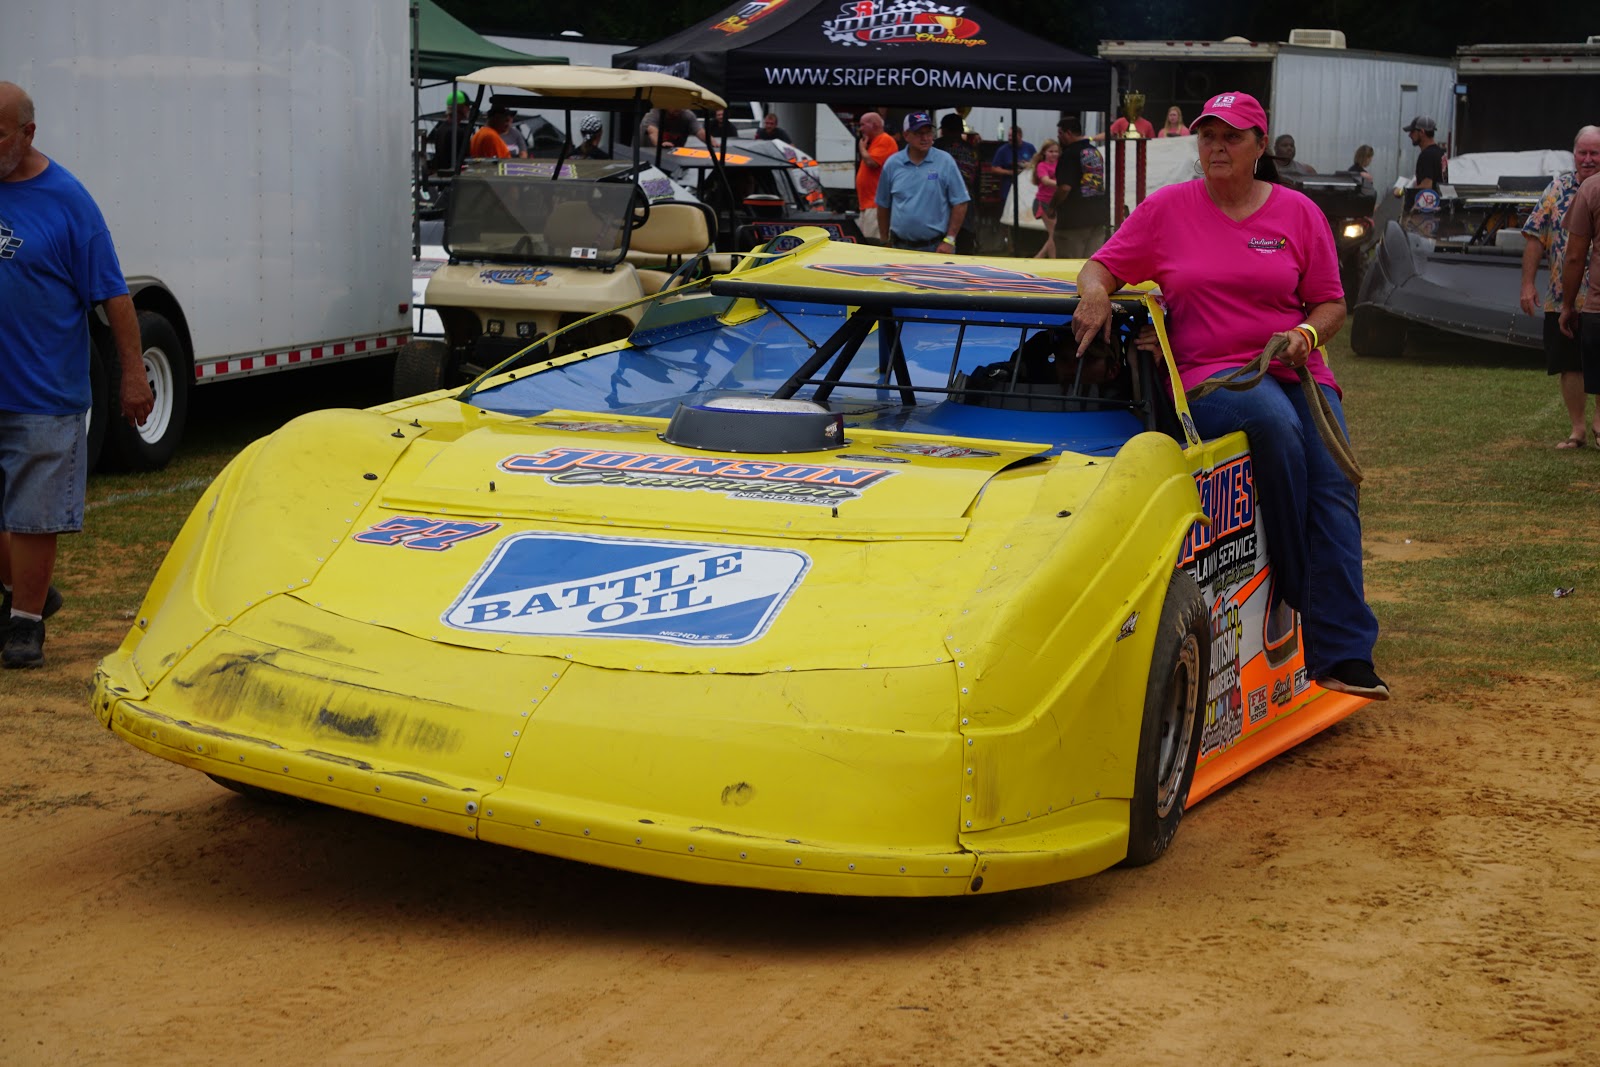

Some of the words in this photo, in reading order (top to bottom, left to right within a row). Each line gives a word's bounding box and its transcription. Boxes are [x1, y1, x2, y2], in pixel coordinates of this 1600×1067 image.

[834, 10, 921, 33] DIRT
[869, 24, 945, 41] CUP
[915, 32, 987, 47] Challenge
[764, 66, 1072, 93] WWW.SRIPERFORMANCE.COM
[504, 449, 889, 487] JOHNSON
[565, 468, 861, 498] Construction
[353, 515, 499, 550] 77
[1197, 550, 1218, 581] LAWN
[1219, 532, 1255, 567] SERVICE
[464, 551, 743, 624] BATTLE
[587, 586, 711, 623] OIL
[1209, 628, 1237, 676] AUTISM
[1207, 664, 1236, 701] AWARENESS
[1251, 689, 1266, 706] FK
[1250, 709, 1267, 721] ENDS
[1254, 702, 1267, 713] ROD
